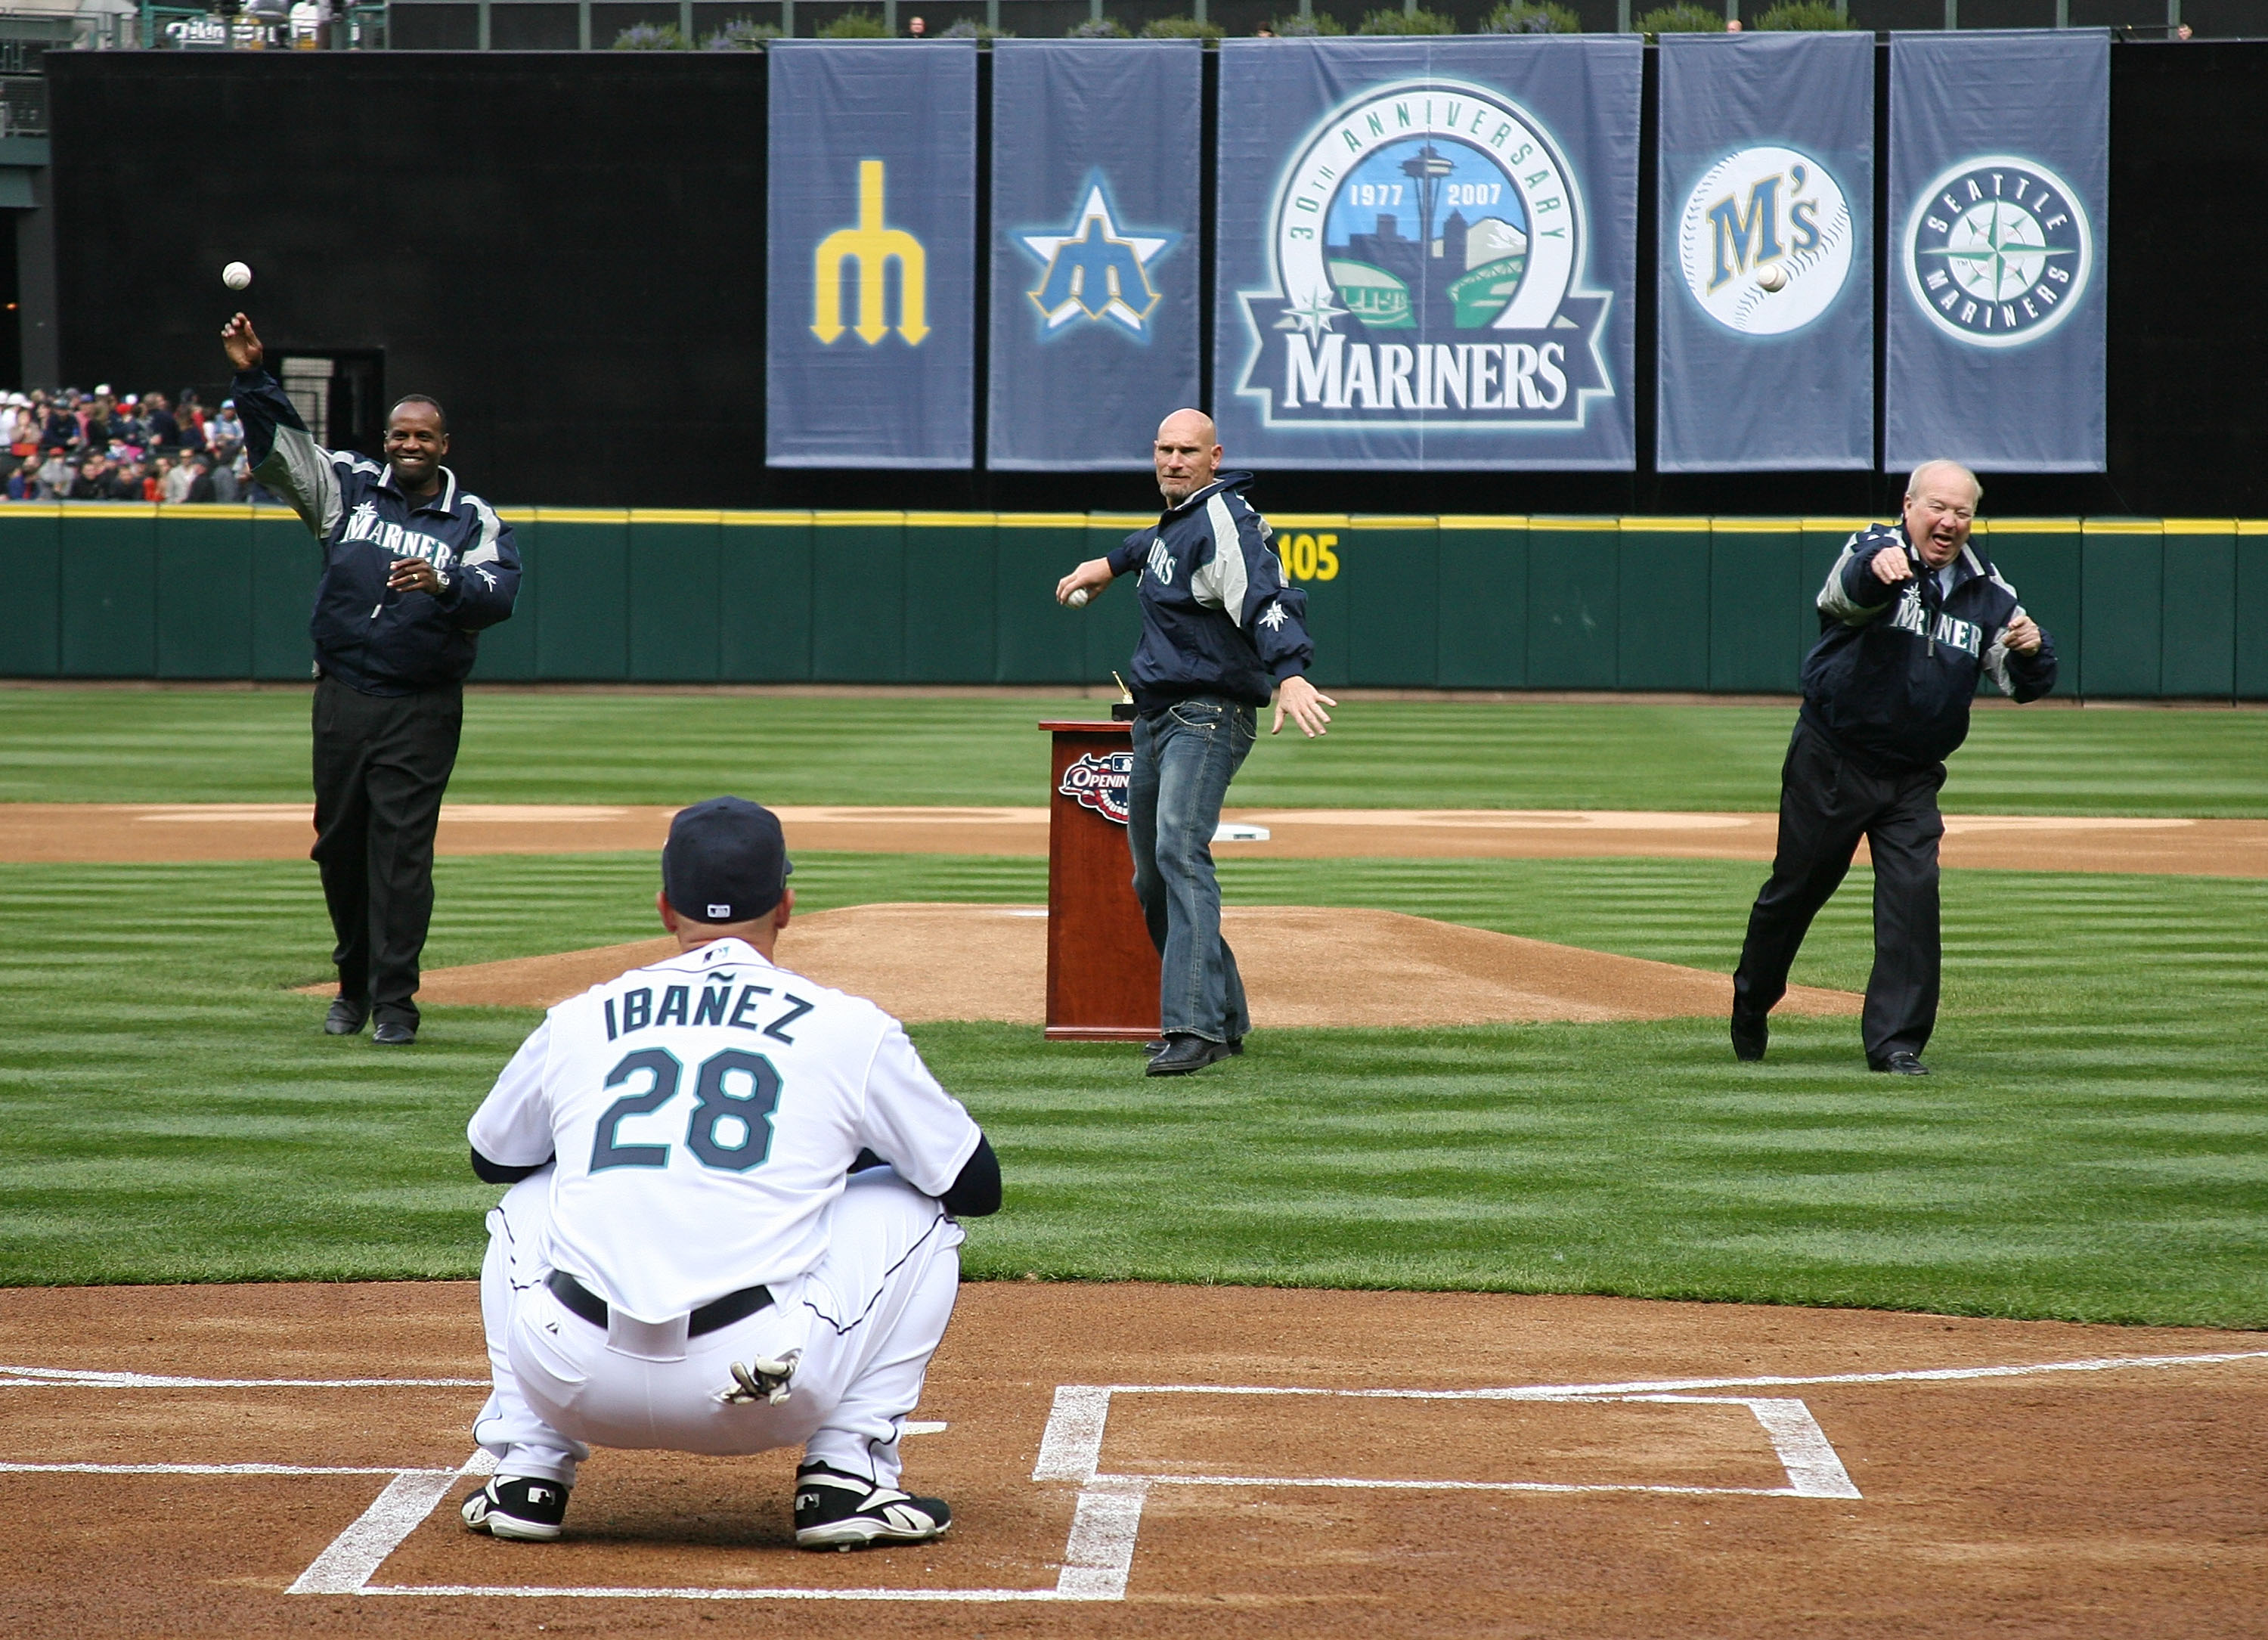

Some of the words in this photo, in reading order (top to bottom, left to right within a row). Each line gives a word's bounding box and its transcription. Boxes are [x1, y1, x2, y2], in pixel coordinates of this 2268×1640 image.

[1341, 99, 1566, 240] ANNIVERSARY
[1350, 184, 1404, 206] 1977
[1447, 183, 1501, 206] 2007
[1927, 174, 2067, 233] SEATTLE
[1926, 266, 2070, 328] MARINERS
[1284, 333, 1567, 411] MARINERS
[1070, 766, 1130, 787] OPENIN
[605, 971, 816, 1046] IBAÑEZ
[587, 1046, 784, 1177] 28
